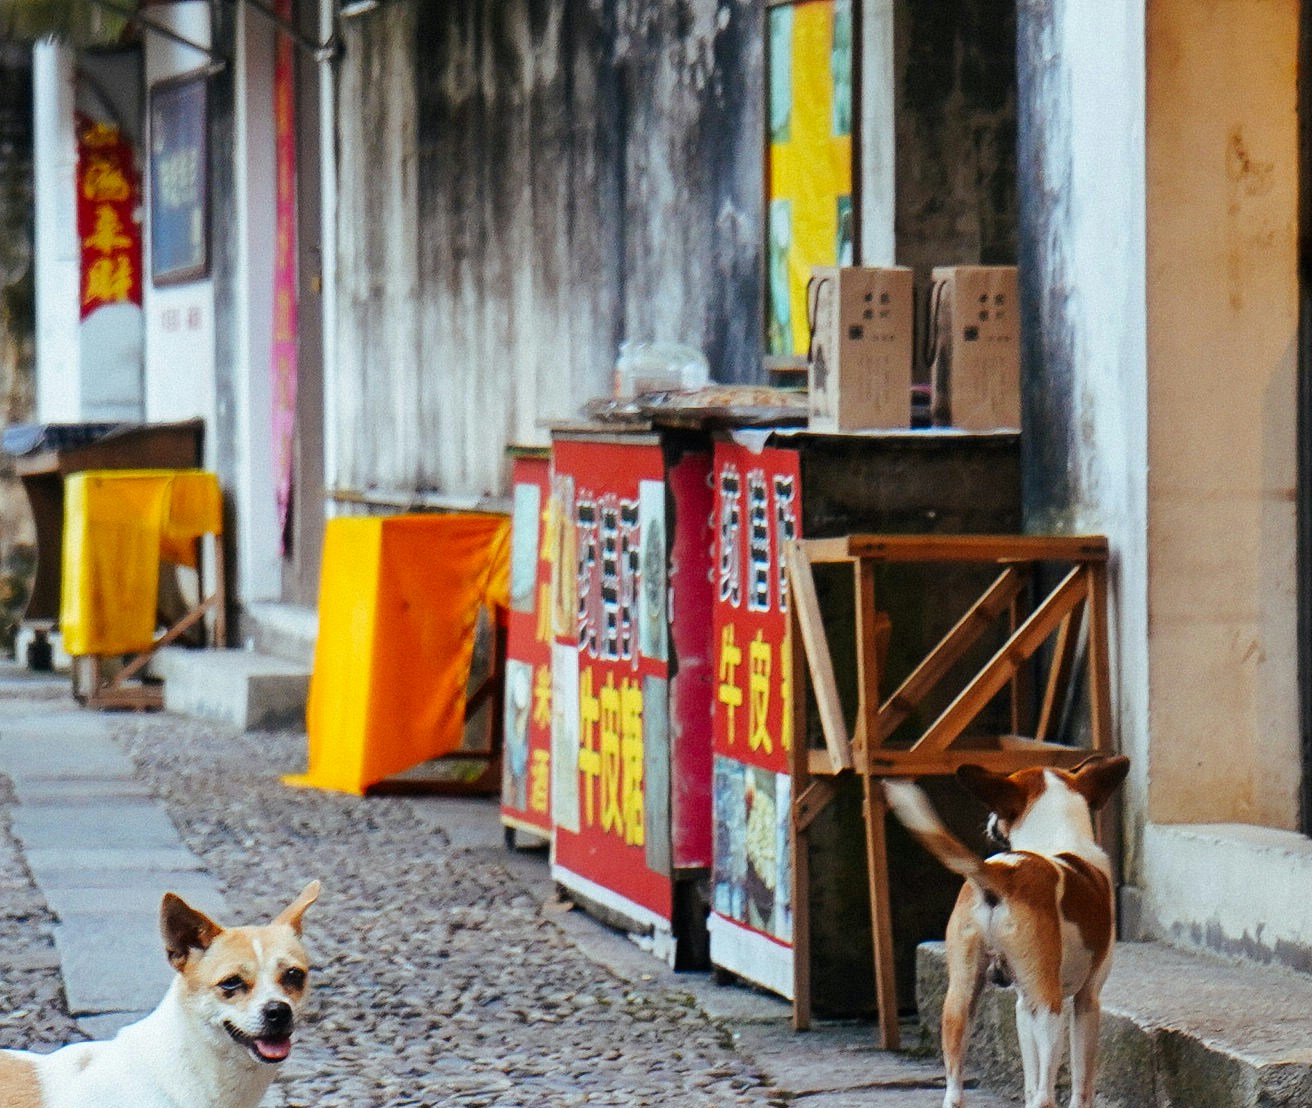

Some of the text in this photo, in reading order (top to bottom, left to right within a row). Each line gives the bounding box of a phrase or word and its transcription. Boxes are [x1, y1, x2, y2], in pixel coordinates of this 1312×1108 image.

[577, 665, 645, 847] 牛皮糖
[718, 623, 790, 754] 牛皮
